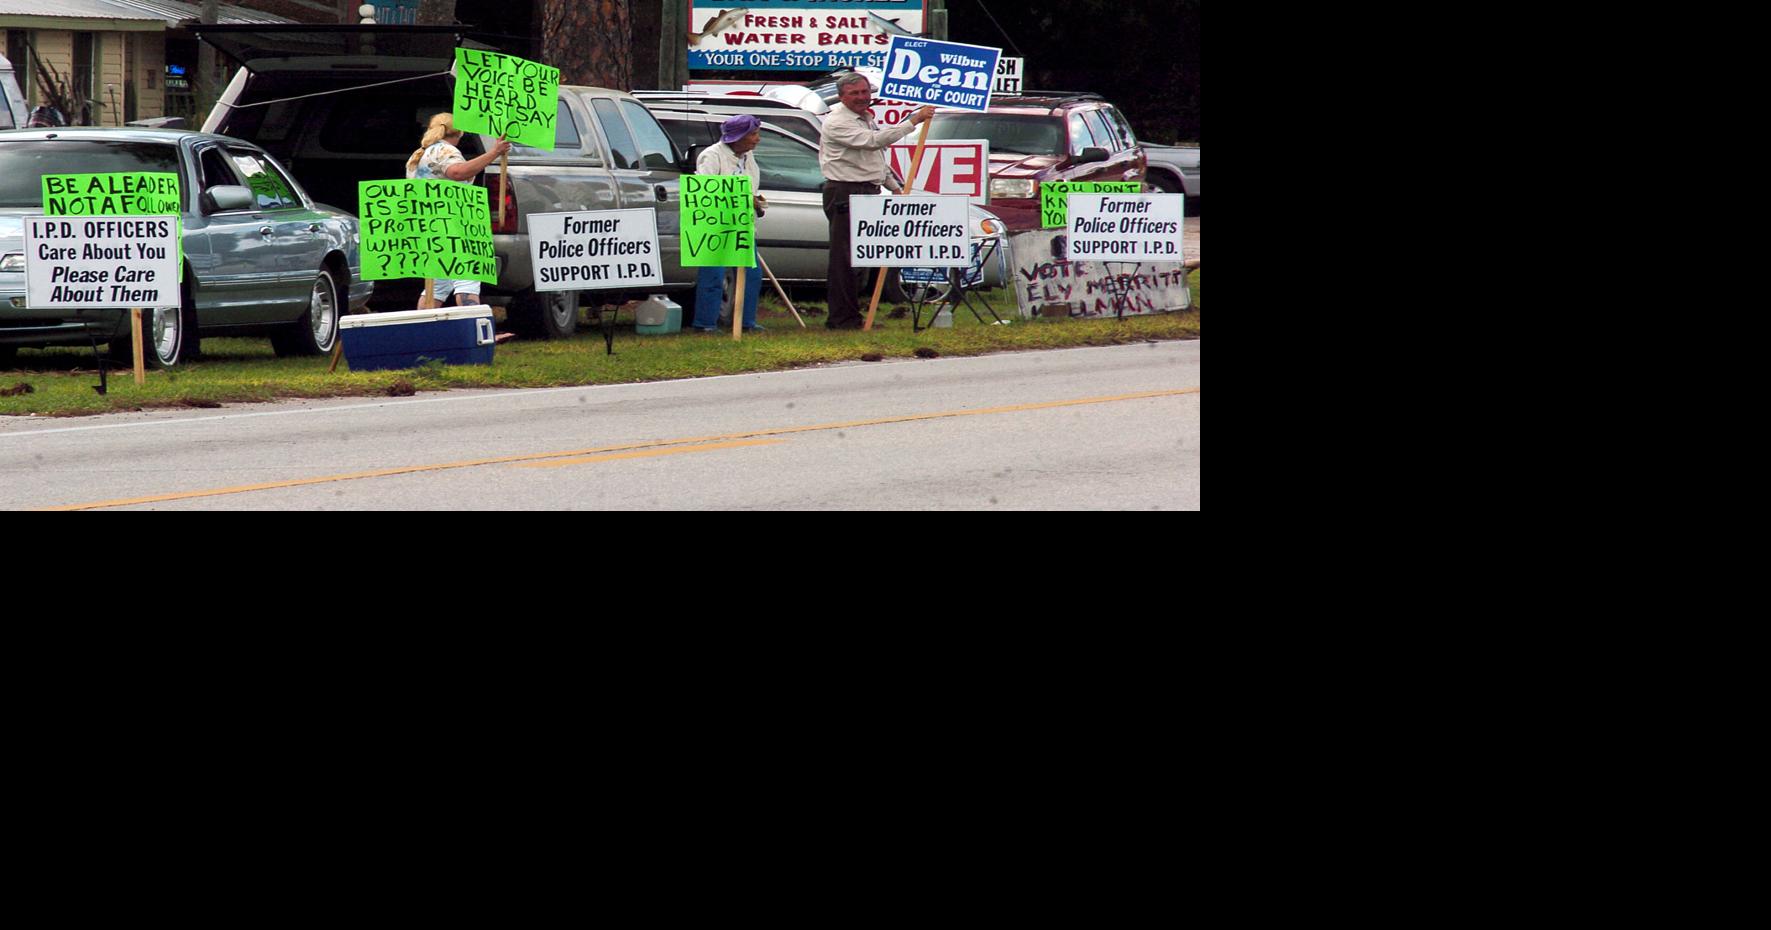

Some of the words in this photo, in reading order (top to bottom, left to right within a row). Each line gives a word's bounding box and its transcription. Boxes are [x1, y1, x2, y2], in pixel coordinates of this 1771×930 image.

[744, 15, 798, 28] FRESH
[810, 15, 818, 28] &
[826, 16, 868, 29] SALT
[724, 32, 805, 45] WATER
[818, 32, 889, 46] BAITS
[464, 50, 508, 69] LET
[511, 58, 559, 86] YOUR
[750, 54, 822, 67] ONE-STOP
[828, 54, 860, 66] BAIT
[888, 48, 988, 90] Dean
[940, 54, 986, 68] Wilbur
[462, 64, 514, 89] VOICE
[523, 78, 548, 96] BE
[466, 81, 537, 110] HEARD
[885, 82, 922, 98] CLERK
[926, 88, 942, 101] OF
[944, 91, 985, 107] COURT
[460, 94, 514, 119] JUST
[515, 106, 554, 128] SAY
[46, 177, 79, 194] BE
[87, 176, 105, 194] A
[109, 176, 178, 195] LEADER
[365, 183, 418, 198] OUR
[425, 182, 485, 205] MOTIVE
[686, 176, 748, 194] DON'T
[1044, 184, 1083, 192] YOU
[1094, 184, 1139, 192] DON'T
[50, 197, 97, 215] NOT
[101, 197, 116, 214] A
[364, 200, 392, 218] IS
[397, 200, 464, 218] SIMPLY
[466, 204, 484, 220] TO
[882, 198, 936, 216] Former
[1100, 197, 1152, 213] Former
[564, 216, 620, 235] Former
[692, 210, 754, 226] POLIC
[1074, 217, 1116, 233] Police
[1120, 217, 1178, 234] Officers
[33, 222, 76, 239] I.P.D.
[84, 221, 168, 238] OFFICERS
[368, 217, 452, 235] PROTECT
[460, 220, 489, 238] YOU
[857, 220, 900, 238] Police
[904, 220, 963, 238] Officers
[38, 243, 77, 260] Care
[82, 243, 132, 260] About
[136, 242, 166, 260] You
[366, 236, 421, 252] WHAT
[427, 236, 444, 254] IS
[446, 236, 494, 259] THEIRS
[539, 240, 584, 259] Police
[588, 237, 651, 257] Officers
[684, 230, 750, 258] VOTE
[856, 245, 922, 260] SUPPORT
[930, 245, 965, 260] I.P.D.
[1073, 240, 1138, 254] SUPPORT
[1144, 241, 1178, 254] I.P.D.
[377, 251, 430, 276] ????
[540, 264, 610, 282] SUPPORT
[617, 262, 655, 279] I.P.D.
[1021, 260, 1088, 282] VOTE
[51, 266, 108, 283] Please
[114, 266, 156, 283] Care
[50, 285, 104, 302] About
[110, 285, 158, 302] Them
